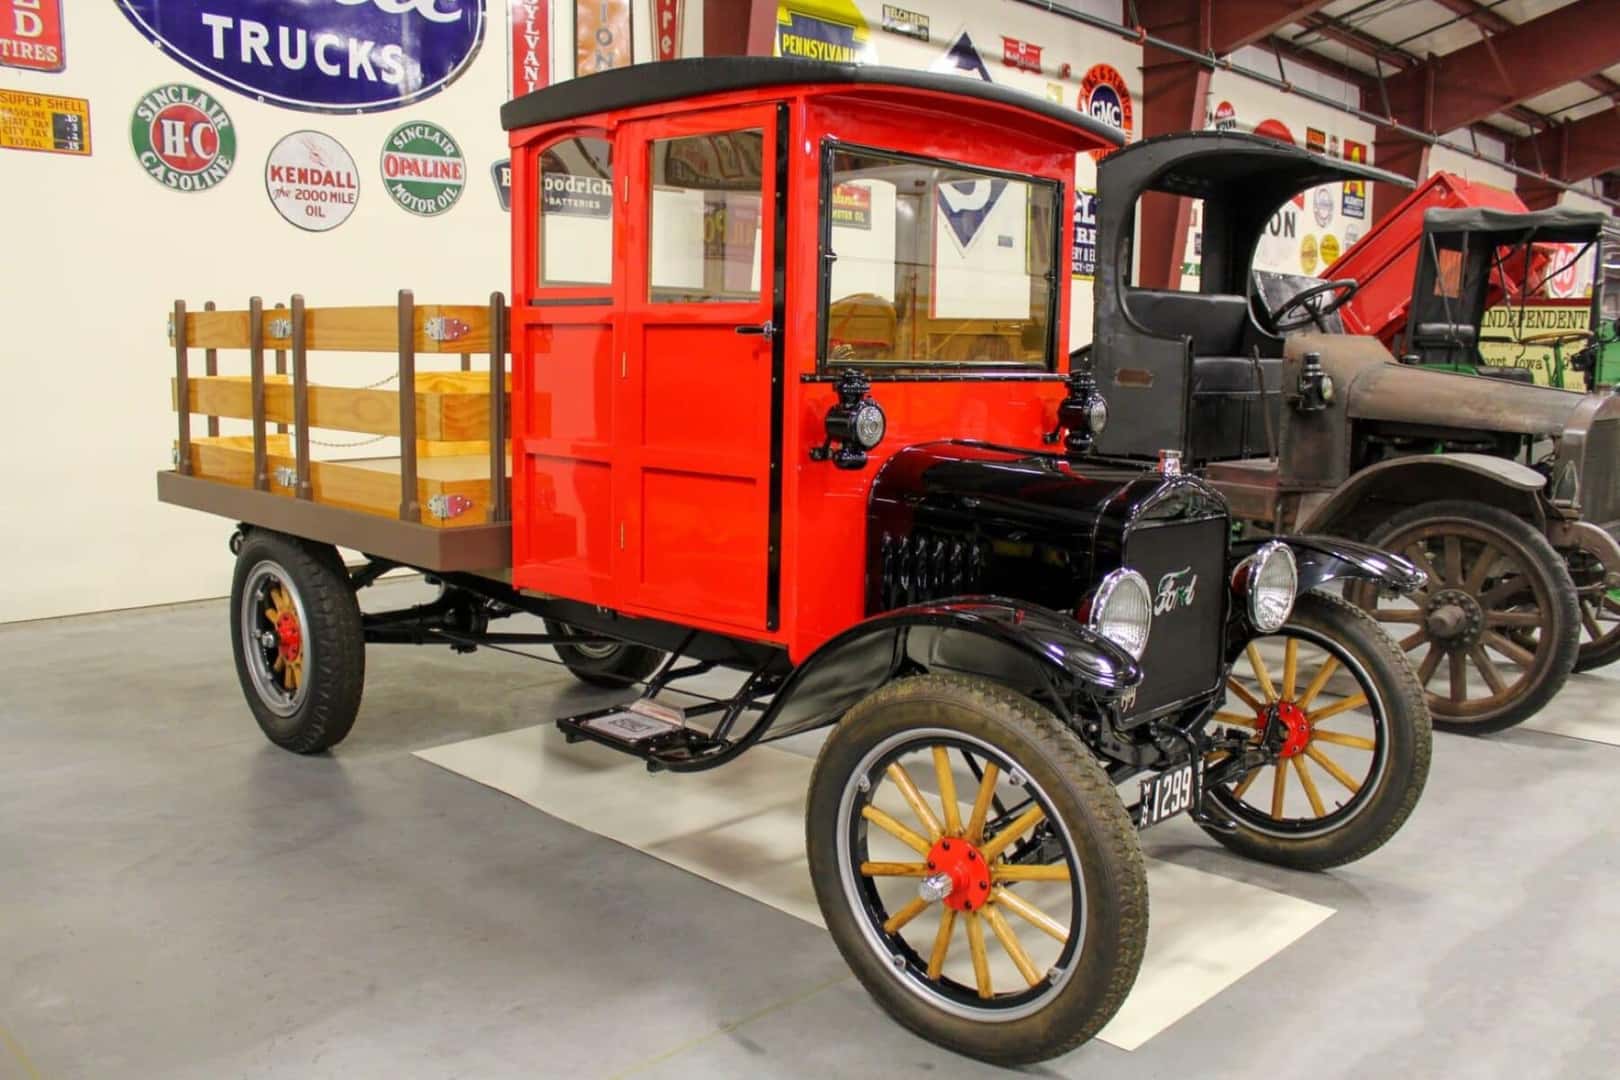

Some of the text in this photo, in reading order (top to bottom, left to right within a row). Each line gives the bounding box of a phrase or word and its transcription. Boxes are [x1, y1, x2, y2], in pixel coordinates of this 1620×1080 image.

[0, 38, 58, 62] TIRES
[202, 13, 405, 84] TRUCKS
[523, 0, 541, 93] YLVANI
[782, 33, 862, 63] PENNSYLVANI
[0, 92, 84, 112] SUPER SHELL
[137, 86, 229, 130] SINCLAIR
[1090, 99, 1121, 127] GMC
[9, 137, 44, 148] TOTAL
[393, 125, 455, 157] SINCLAIR
[140, 151, 232, 191] GASOLINE
[270, 164, 356, 189] KENDALL
[384, 153, 462, 180] OPALINE
[295, 188, 328, 202] 2000
[329, 191, 355, 205] MILE
[391, 183, 458, 212] MOTOR OIL
[545, 175, 612, 196] oodrich
[305, 204, 326, 218] OIL
[1153, 565, 1198, 617] Ford
[1153, 765, 1193, 822] 1299
